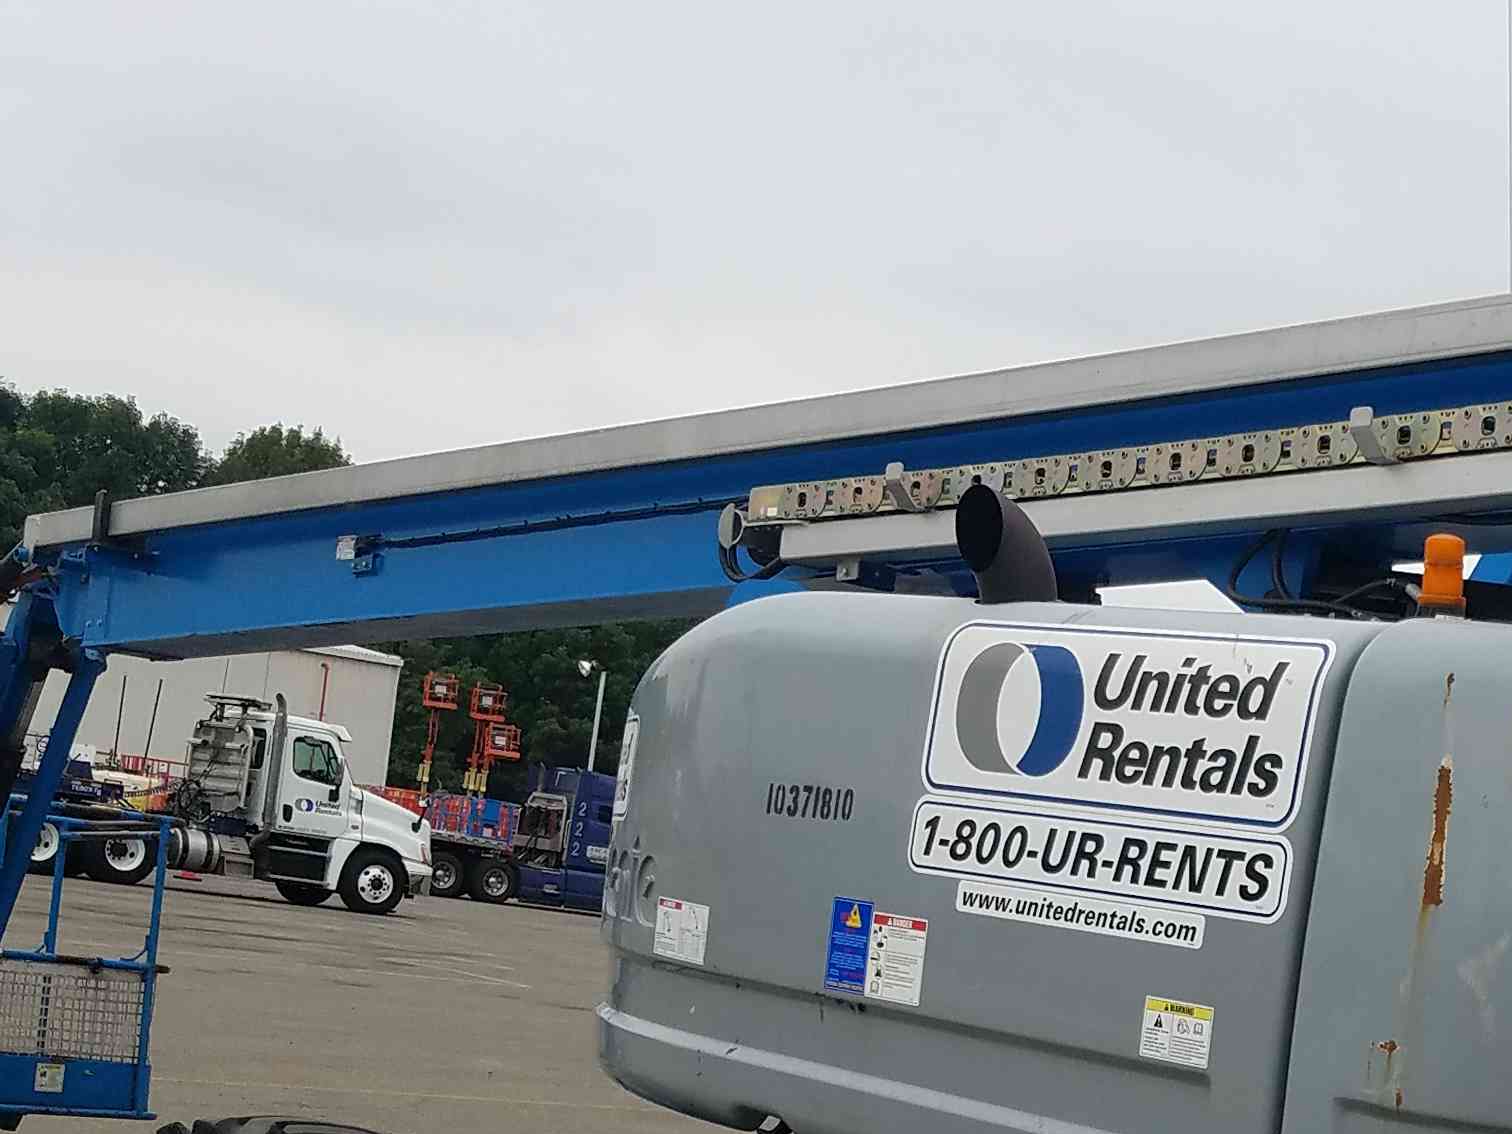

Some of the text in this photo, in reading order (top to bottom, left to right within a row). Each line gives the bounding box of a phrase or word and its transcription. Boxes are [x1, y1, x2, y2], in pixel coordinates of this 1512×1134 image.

[1092, 652, 1291, 722] United
[1078, 722, 1284, 798] Rentals
[766, 783, 854, 821] 10371810
[919, 815, 1272, 903] 1-800-UR-RENTS
[961, 888, 1198, 943] www.unitedrentals.com
